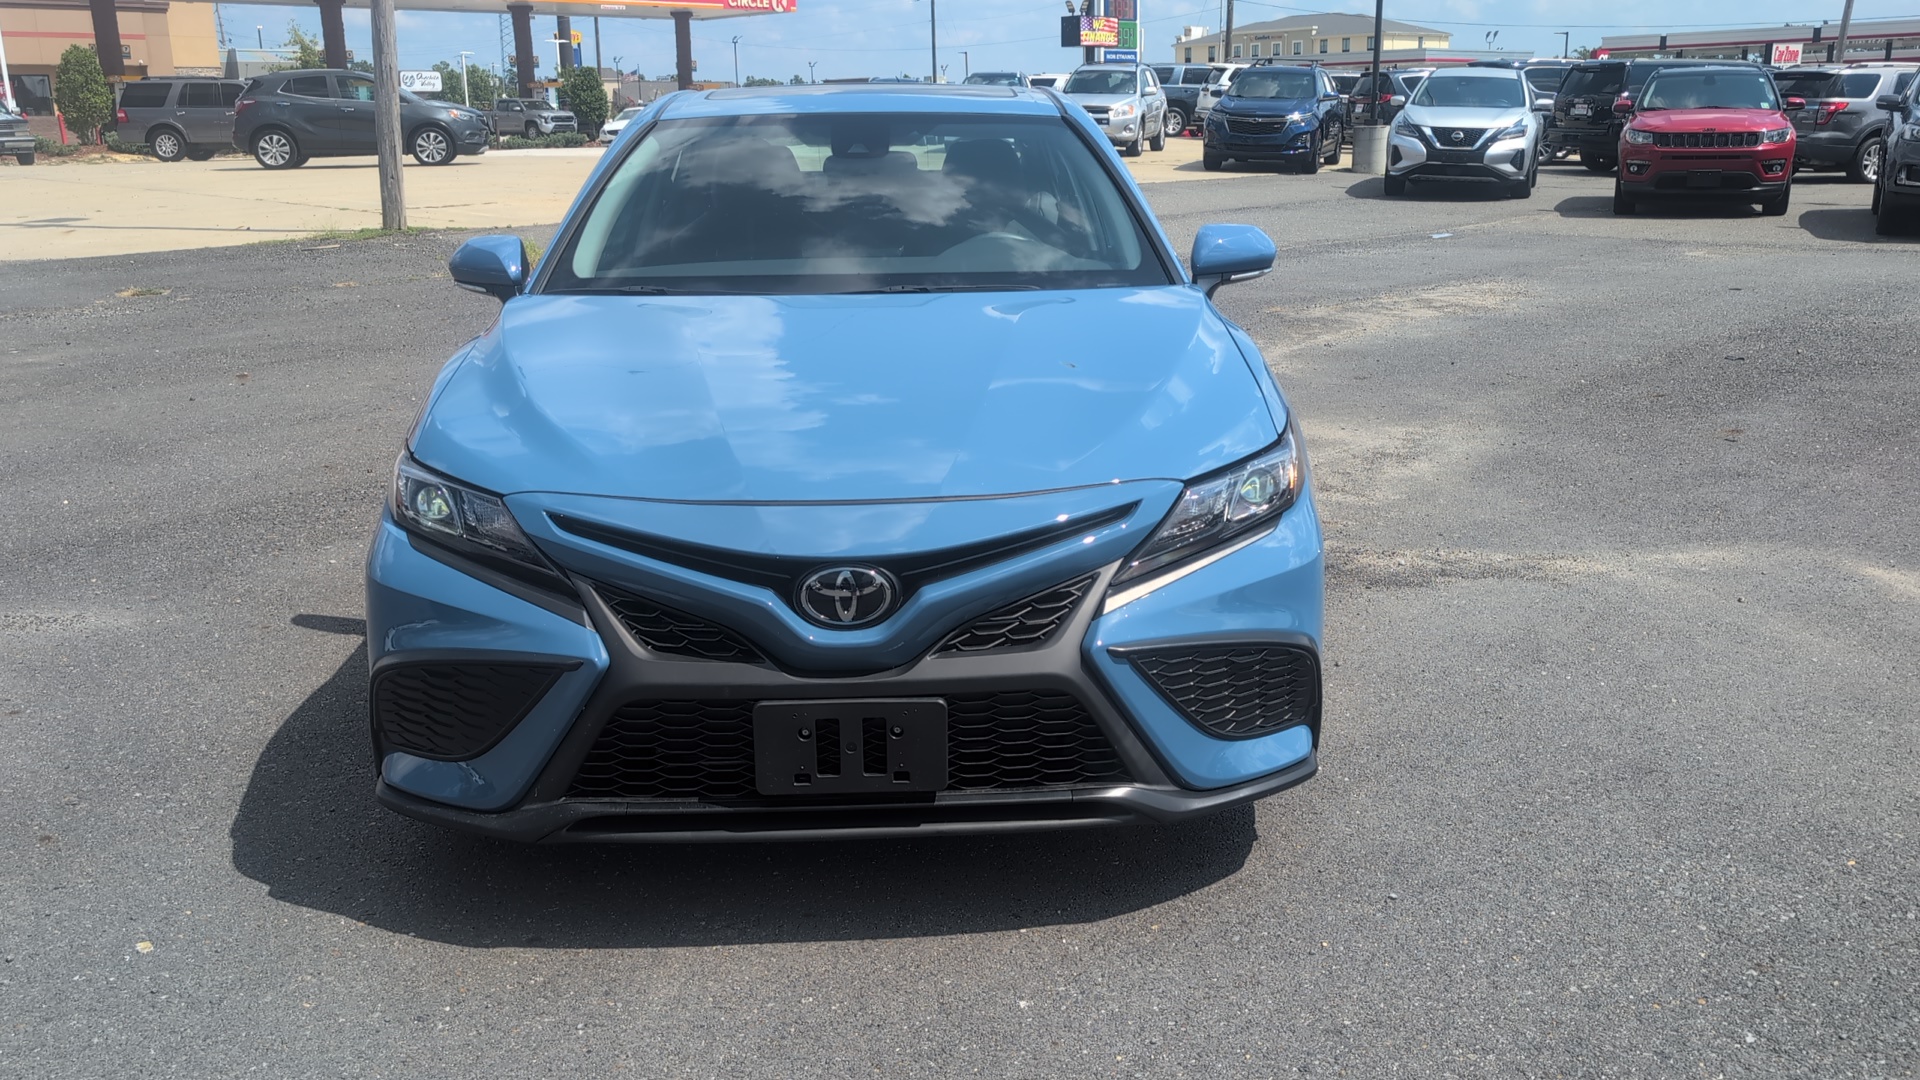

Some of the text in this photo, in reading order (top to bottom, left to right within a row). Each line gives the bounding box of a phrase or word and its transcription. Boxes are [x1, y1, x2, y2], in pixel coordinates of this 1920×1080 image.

[728, 0, 770, 8] CIRCLE
[1093, 19, 1105, 29] WE
[1083, 32, 1116, 43] FINANCE
